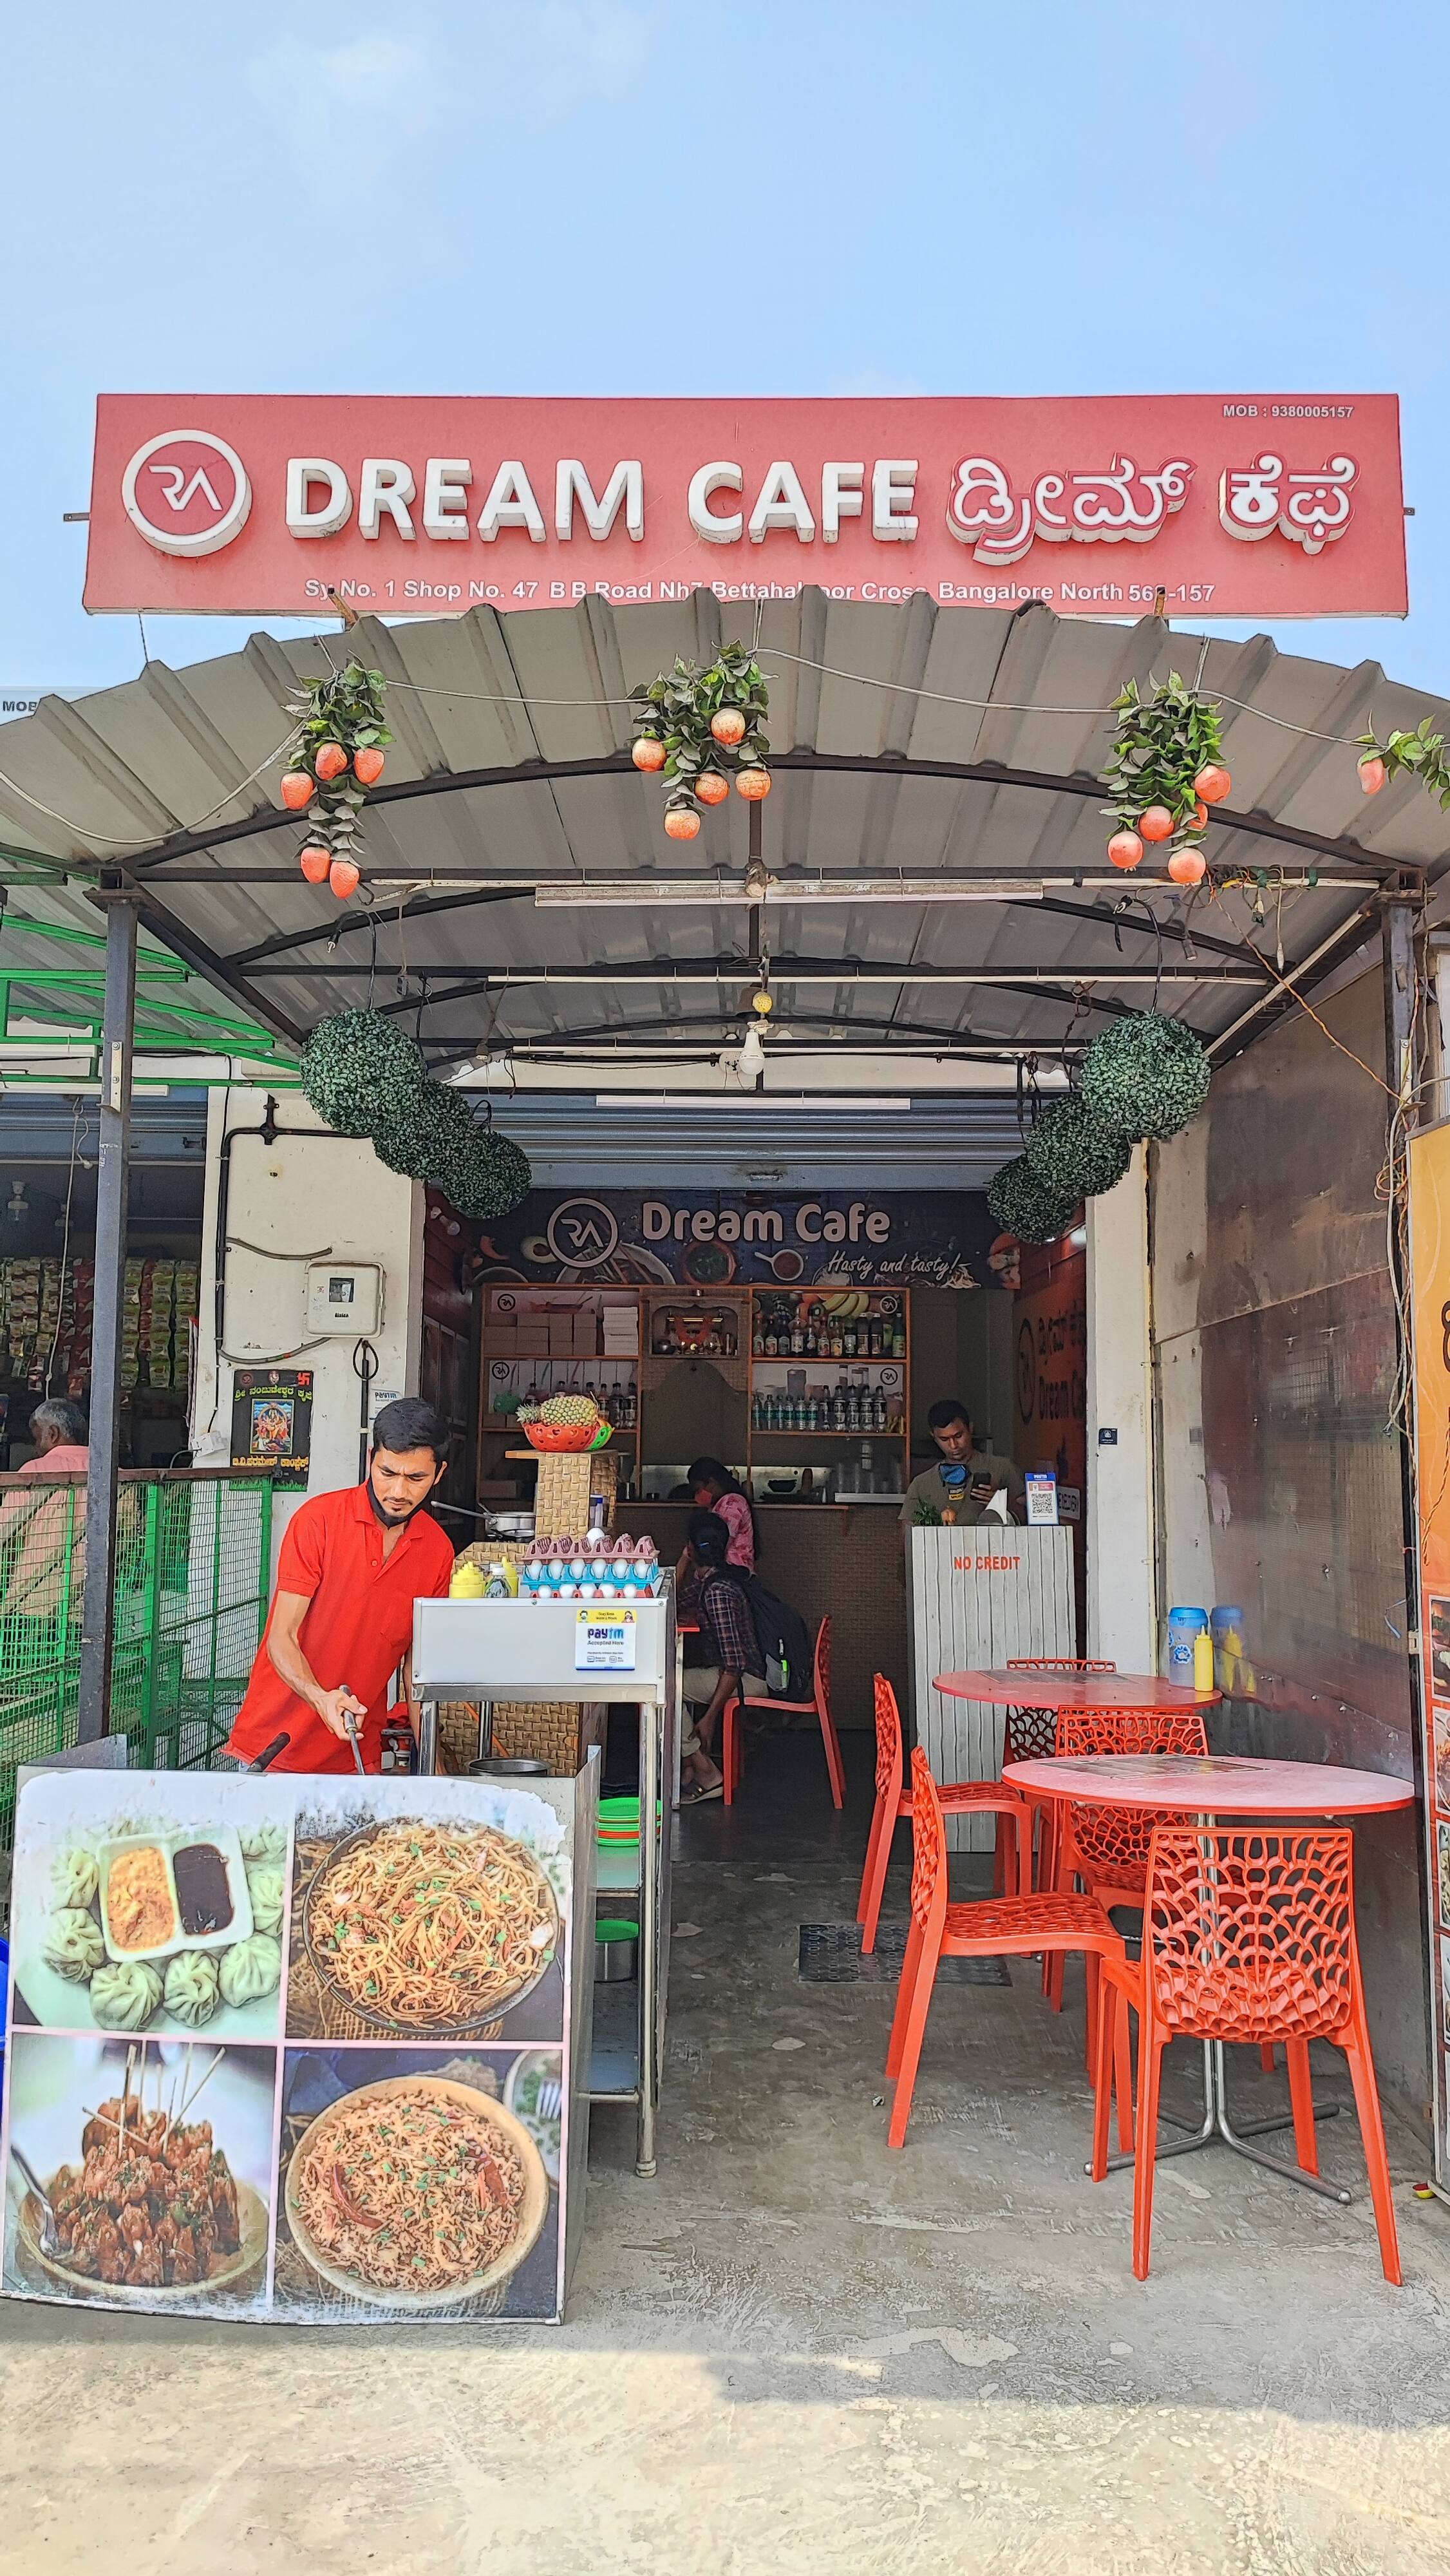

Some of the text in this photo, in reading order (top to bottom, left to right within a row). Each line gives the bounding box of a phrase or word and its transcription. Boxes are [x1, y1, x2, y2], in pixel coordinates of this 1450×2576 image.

[1223, 404, 1259, 417] MOB
[1271, 405, 1354, 418] 9380005157
[286, 457, 919, 544] DREAM CAFE
[1219, 450, 1361, 555] ಕೆಫೆ
[340, 579, 377, 598] No.
[384, 580, 395, 598] 1
[403, 579, 462, 601] Shop
[468, 580, 505, 598] No.
[512, 581, 539, 598] 47
[549, 581, 566, 599] B
[570, 581, 587, 599] B
[594, 581, 652, 599] Road
[711, 581, 855, 600] Bettahaloor
[939, 582, 1054, 603] Bangalore
[1060, 583, 1124, 601] North
[643, 1202, 890, 1244] Dream Cafe
[827, 1250, 961, 1281] Hasty and tasty!
[954, 1556, 1021, 1570] NO CREDIT
